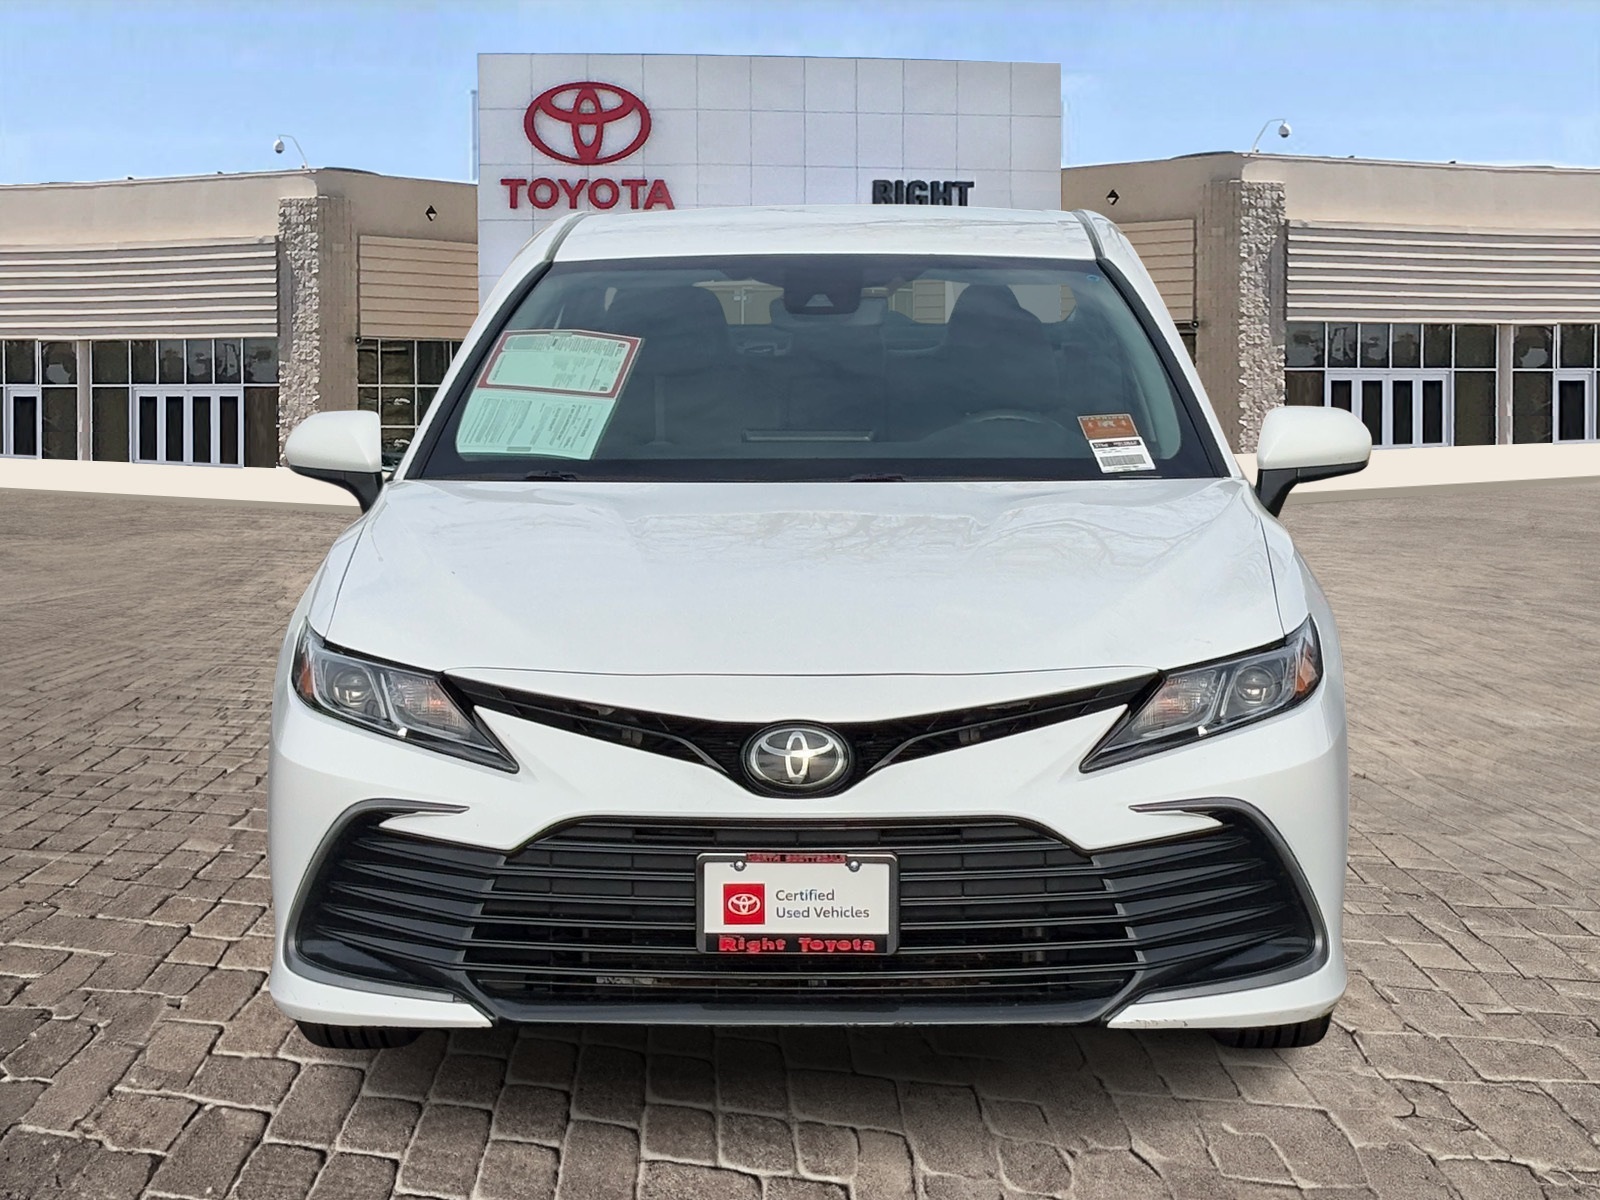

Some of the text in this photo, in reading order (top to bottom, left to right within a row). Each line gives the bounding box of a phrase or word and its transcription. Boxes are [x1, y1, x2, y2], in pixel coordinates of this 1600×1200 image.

[500, 177, 675, 210] TOYOTA
[872, 179, 975, 206] RIGHT
[775, 889, 835, 902] Certified
[775, 906, 870, 919] Used Vehicles
[718, 935, 876, 953] Right Toyota
